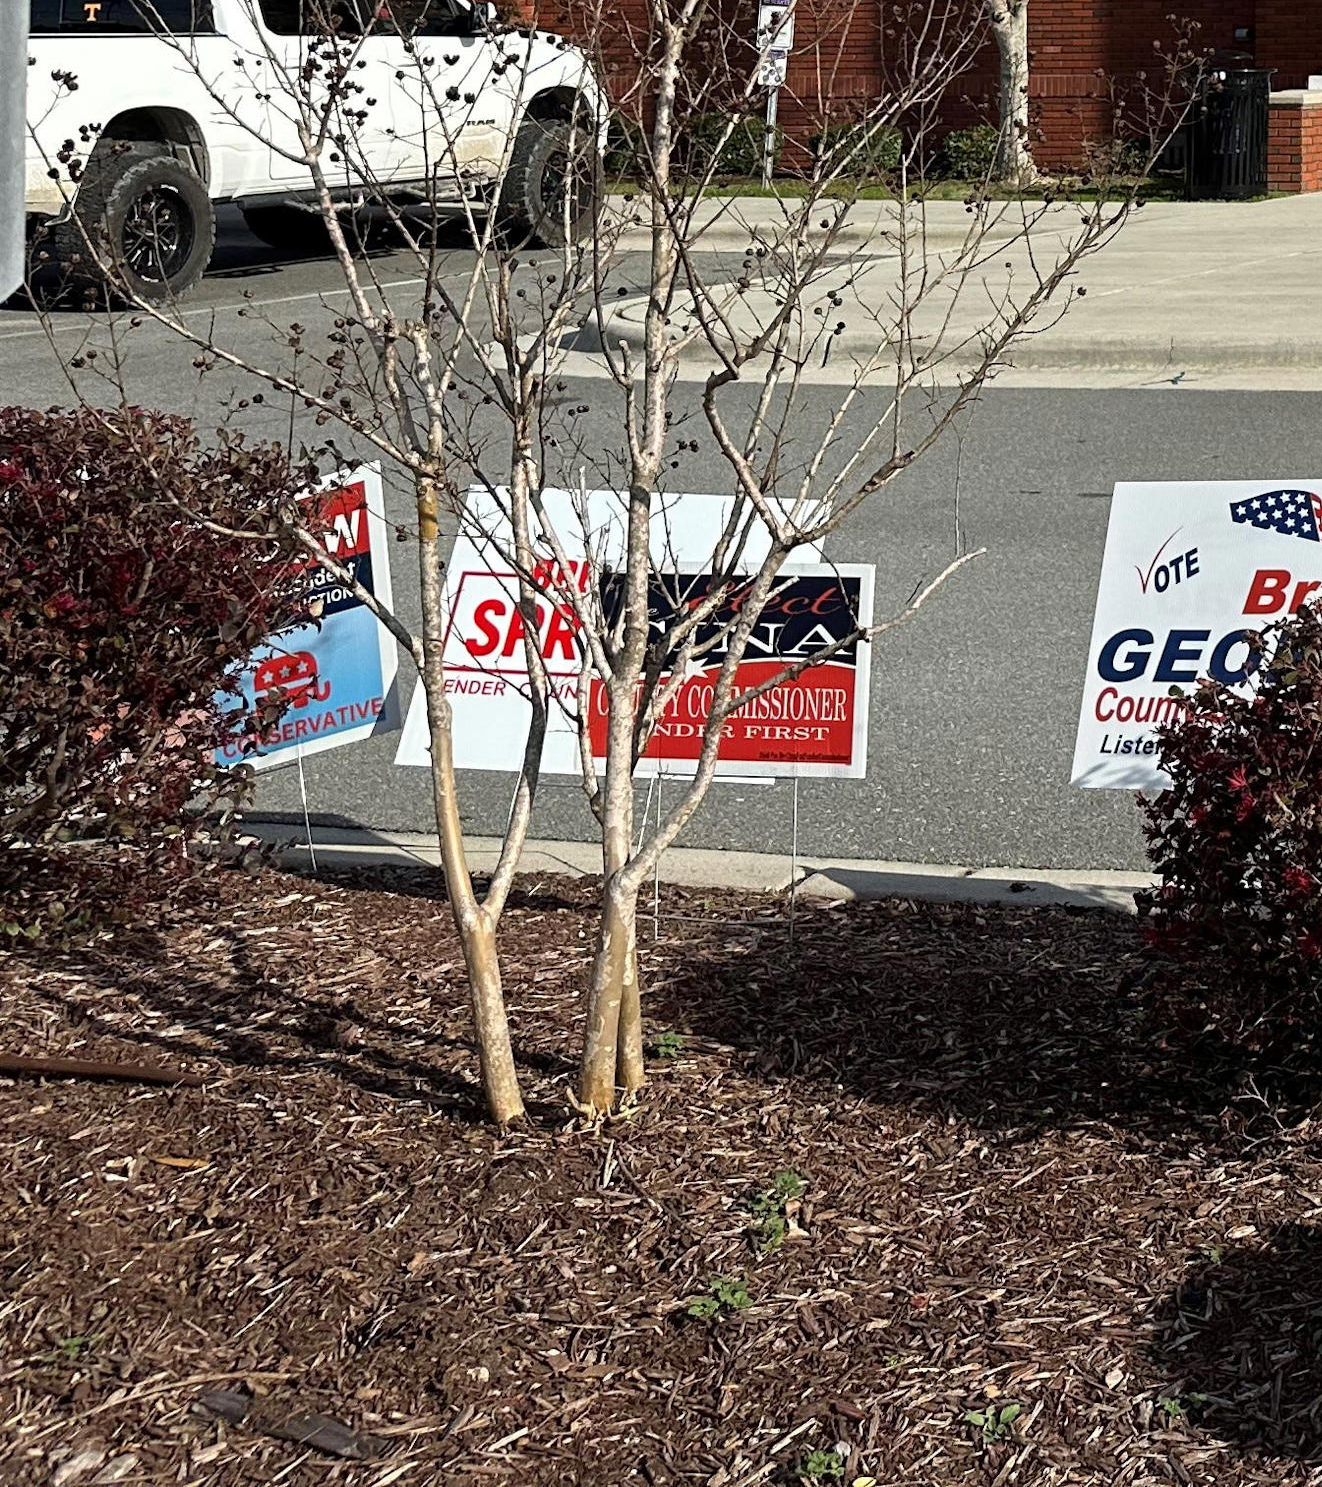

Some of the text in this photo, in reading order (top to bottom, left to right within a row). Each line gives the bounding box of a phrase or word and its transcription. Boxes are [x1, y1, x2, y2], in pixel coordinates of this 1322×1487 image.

[84, 3, 102, 22] T
[444, 678, 506, 697] ENDER
[688, 684, 847, 722] COMISSIONER
[223, 696, 384, 758] COSERVATIVE
[744, 724, 830, 741] FIRST
